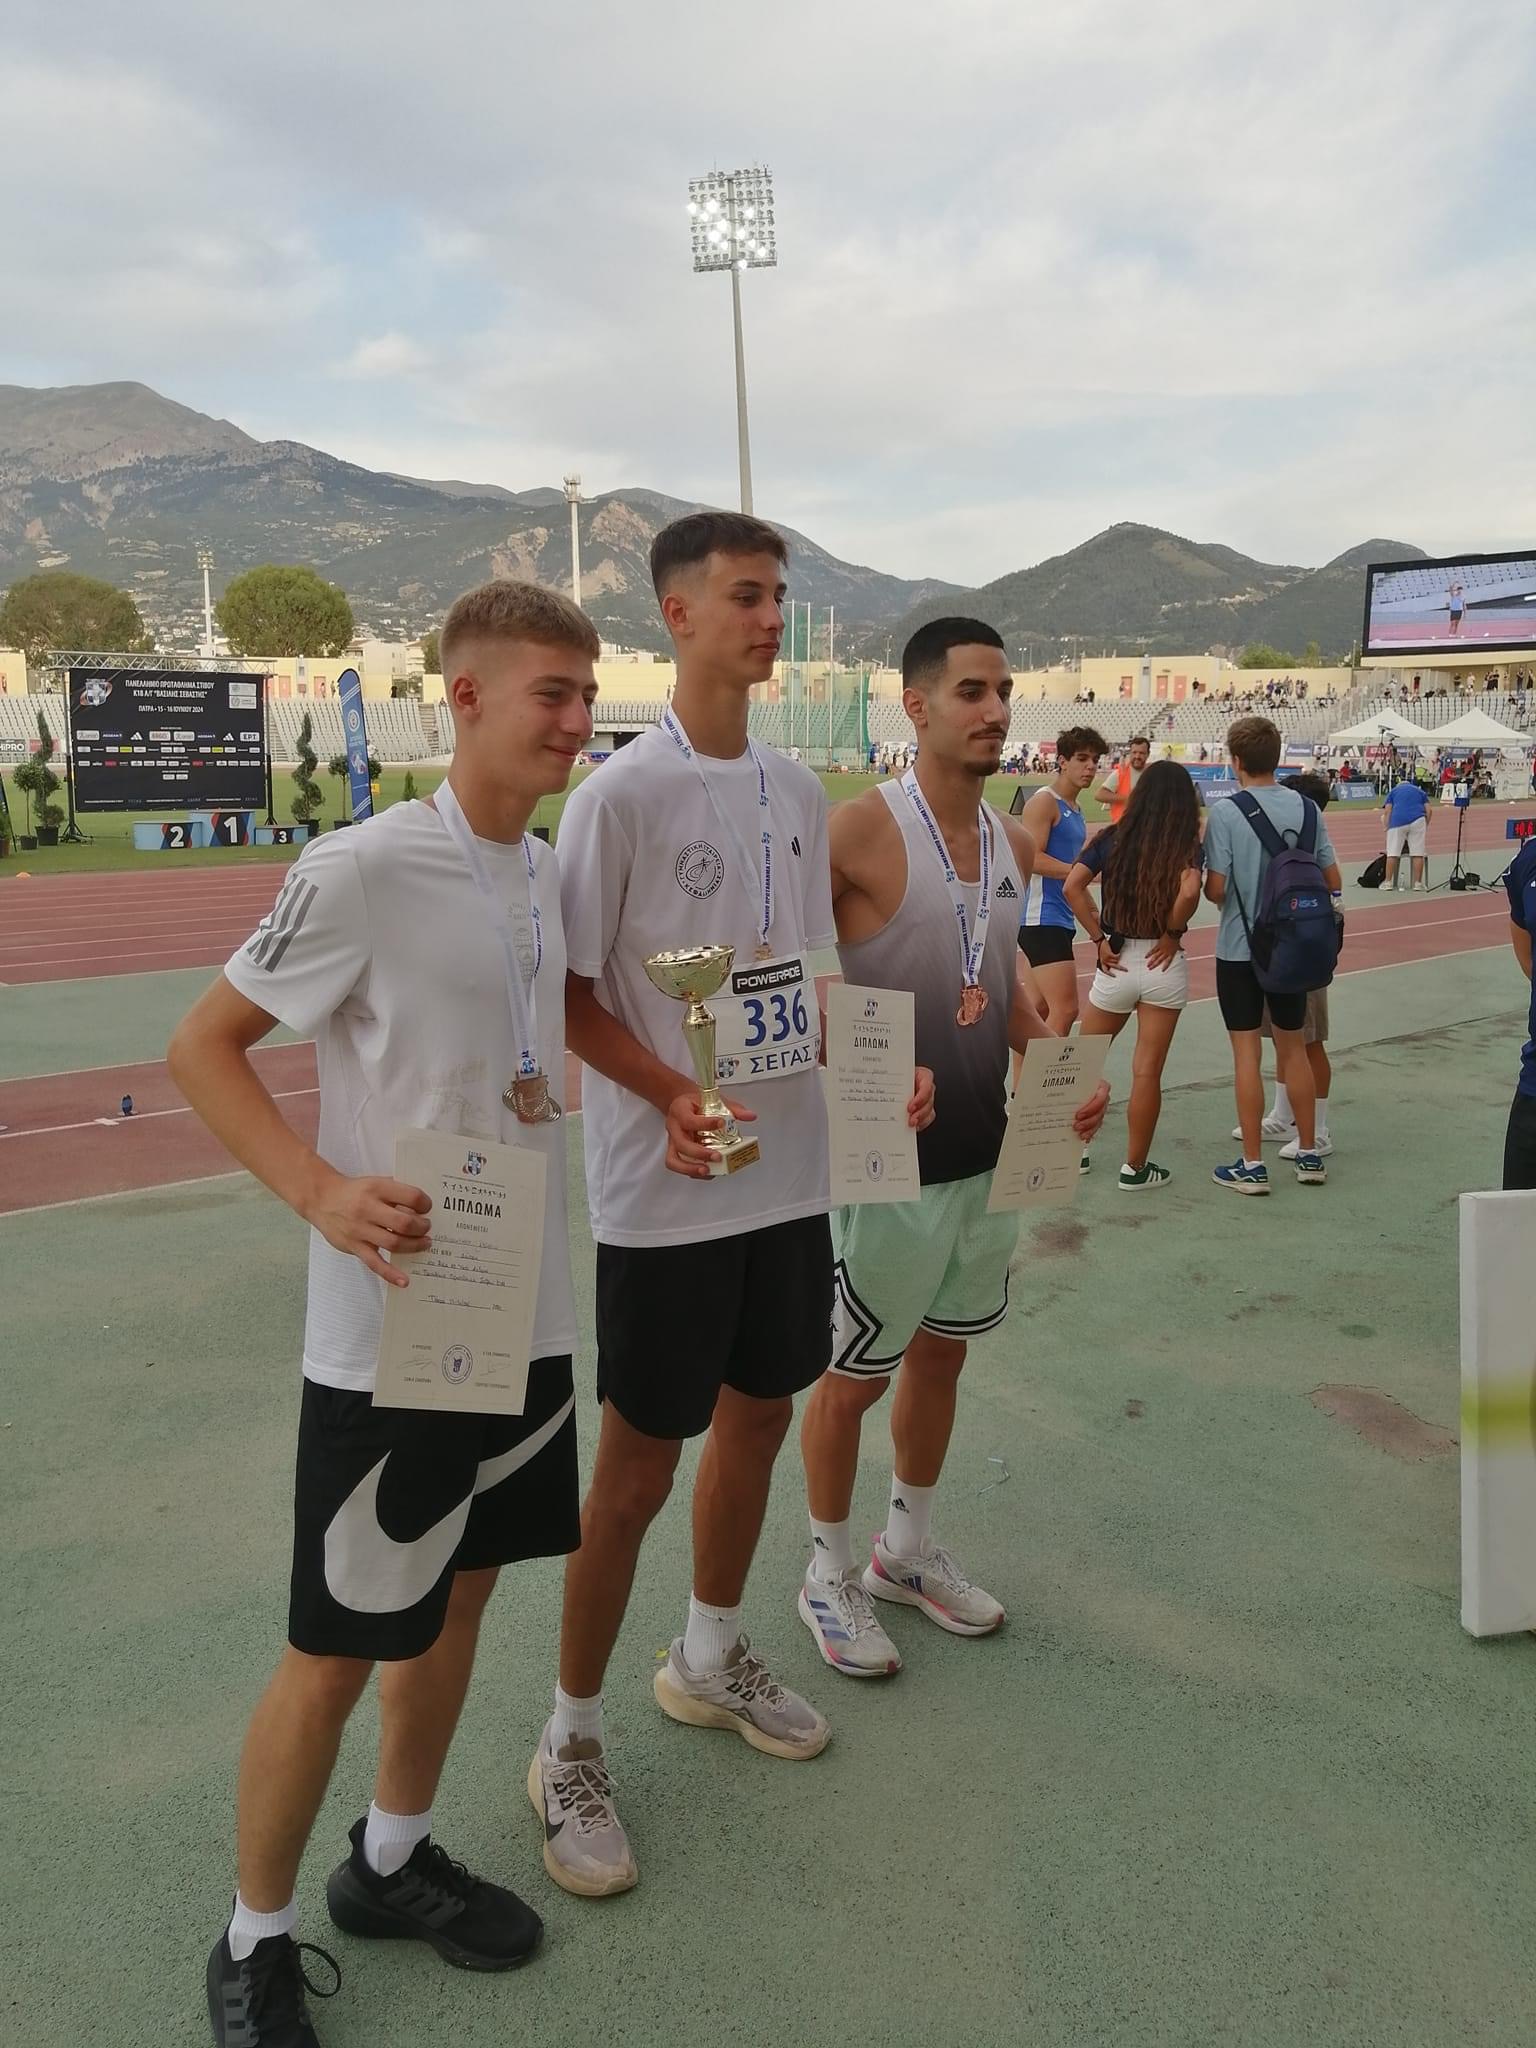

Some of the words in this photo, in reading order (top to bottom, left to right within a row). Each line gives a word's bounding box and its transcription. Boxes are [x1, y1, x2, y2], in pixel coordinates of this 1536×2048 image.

[170, 826, 184, 848] 2
[224, 817, 237, 843] 1
[279, 831, 287, 843] 3
[736, 965, 801, 989] POWERADE
[744, 988, 808, 1047] 336
[854, 1037, 889, 1049] ΔΙΠΛΩΜΑ
[750, 1045, 812, 1074] ΣΕΓΑΣ
[1042, 1076, 1075, 1088] ΔΙΠΛΩΜΑ
[443, 1196, 501, 1218] ΔΙΠΛΩΜΑ
